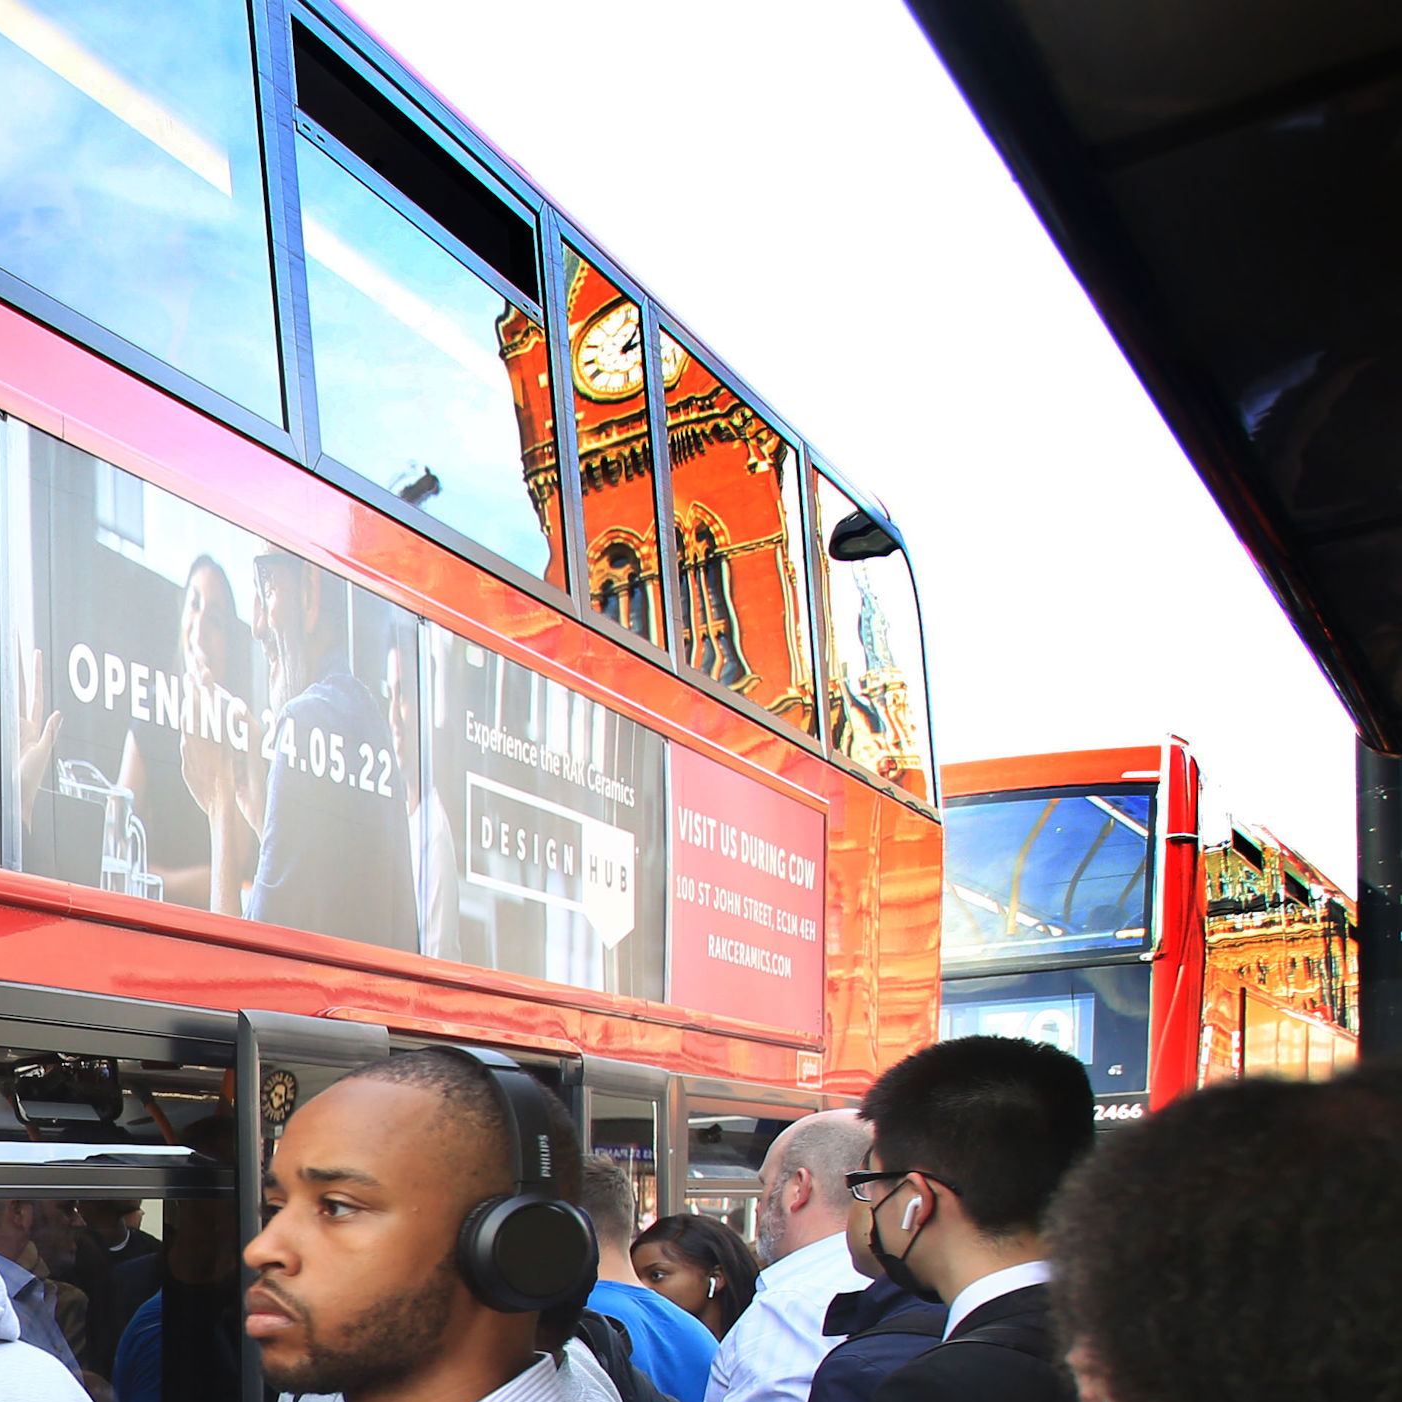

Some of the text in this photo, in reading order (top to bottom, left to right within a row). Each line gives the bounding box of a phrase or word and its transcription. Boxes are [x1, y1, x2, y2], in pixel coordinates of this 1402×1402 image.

[68, 642, 393, 798] OPENING 24.05.22
[465, 709, 635, 808] Experience the RAK Ceramics
[481, 815, 627, 893] DESIGN HUB
[678, 805, 816, 891] VISIT US DURING CDW
[676, 874, 817, 942] 100 ST JOHN STREET, EC1M 4EH
[708, 933, 792, 980] RAKCERAMICS.COM
